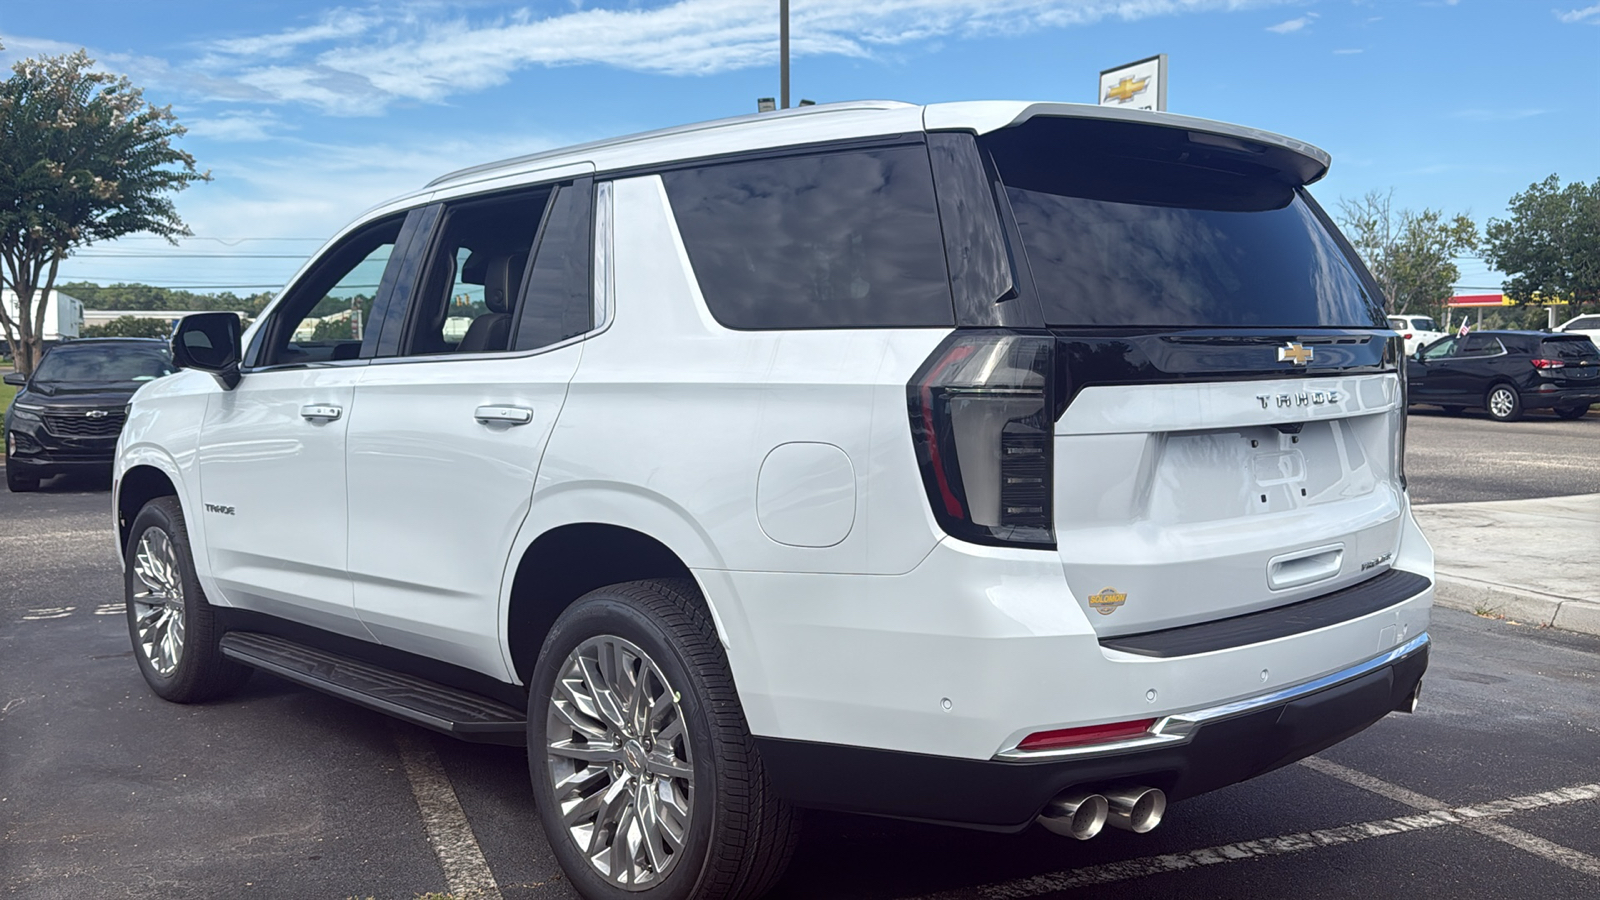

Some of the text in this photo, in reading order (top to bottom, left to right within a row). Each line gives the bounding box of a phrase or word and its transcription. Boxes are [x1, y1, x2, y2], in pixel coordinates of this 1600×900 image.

[1256, 391, 1338, 409] TAHOE
[204, 503, 235, 515] TAHOE
[1090, 594, 1125, 603] SOLOMON
